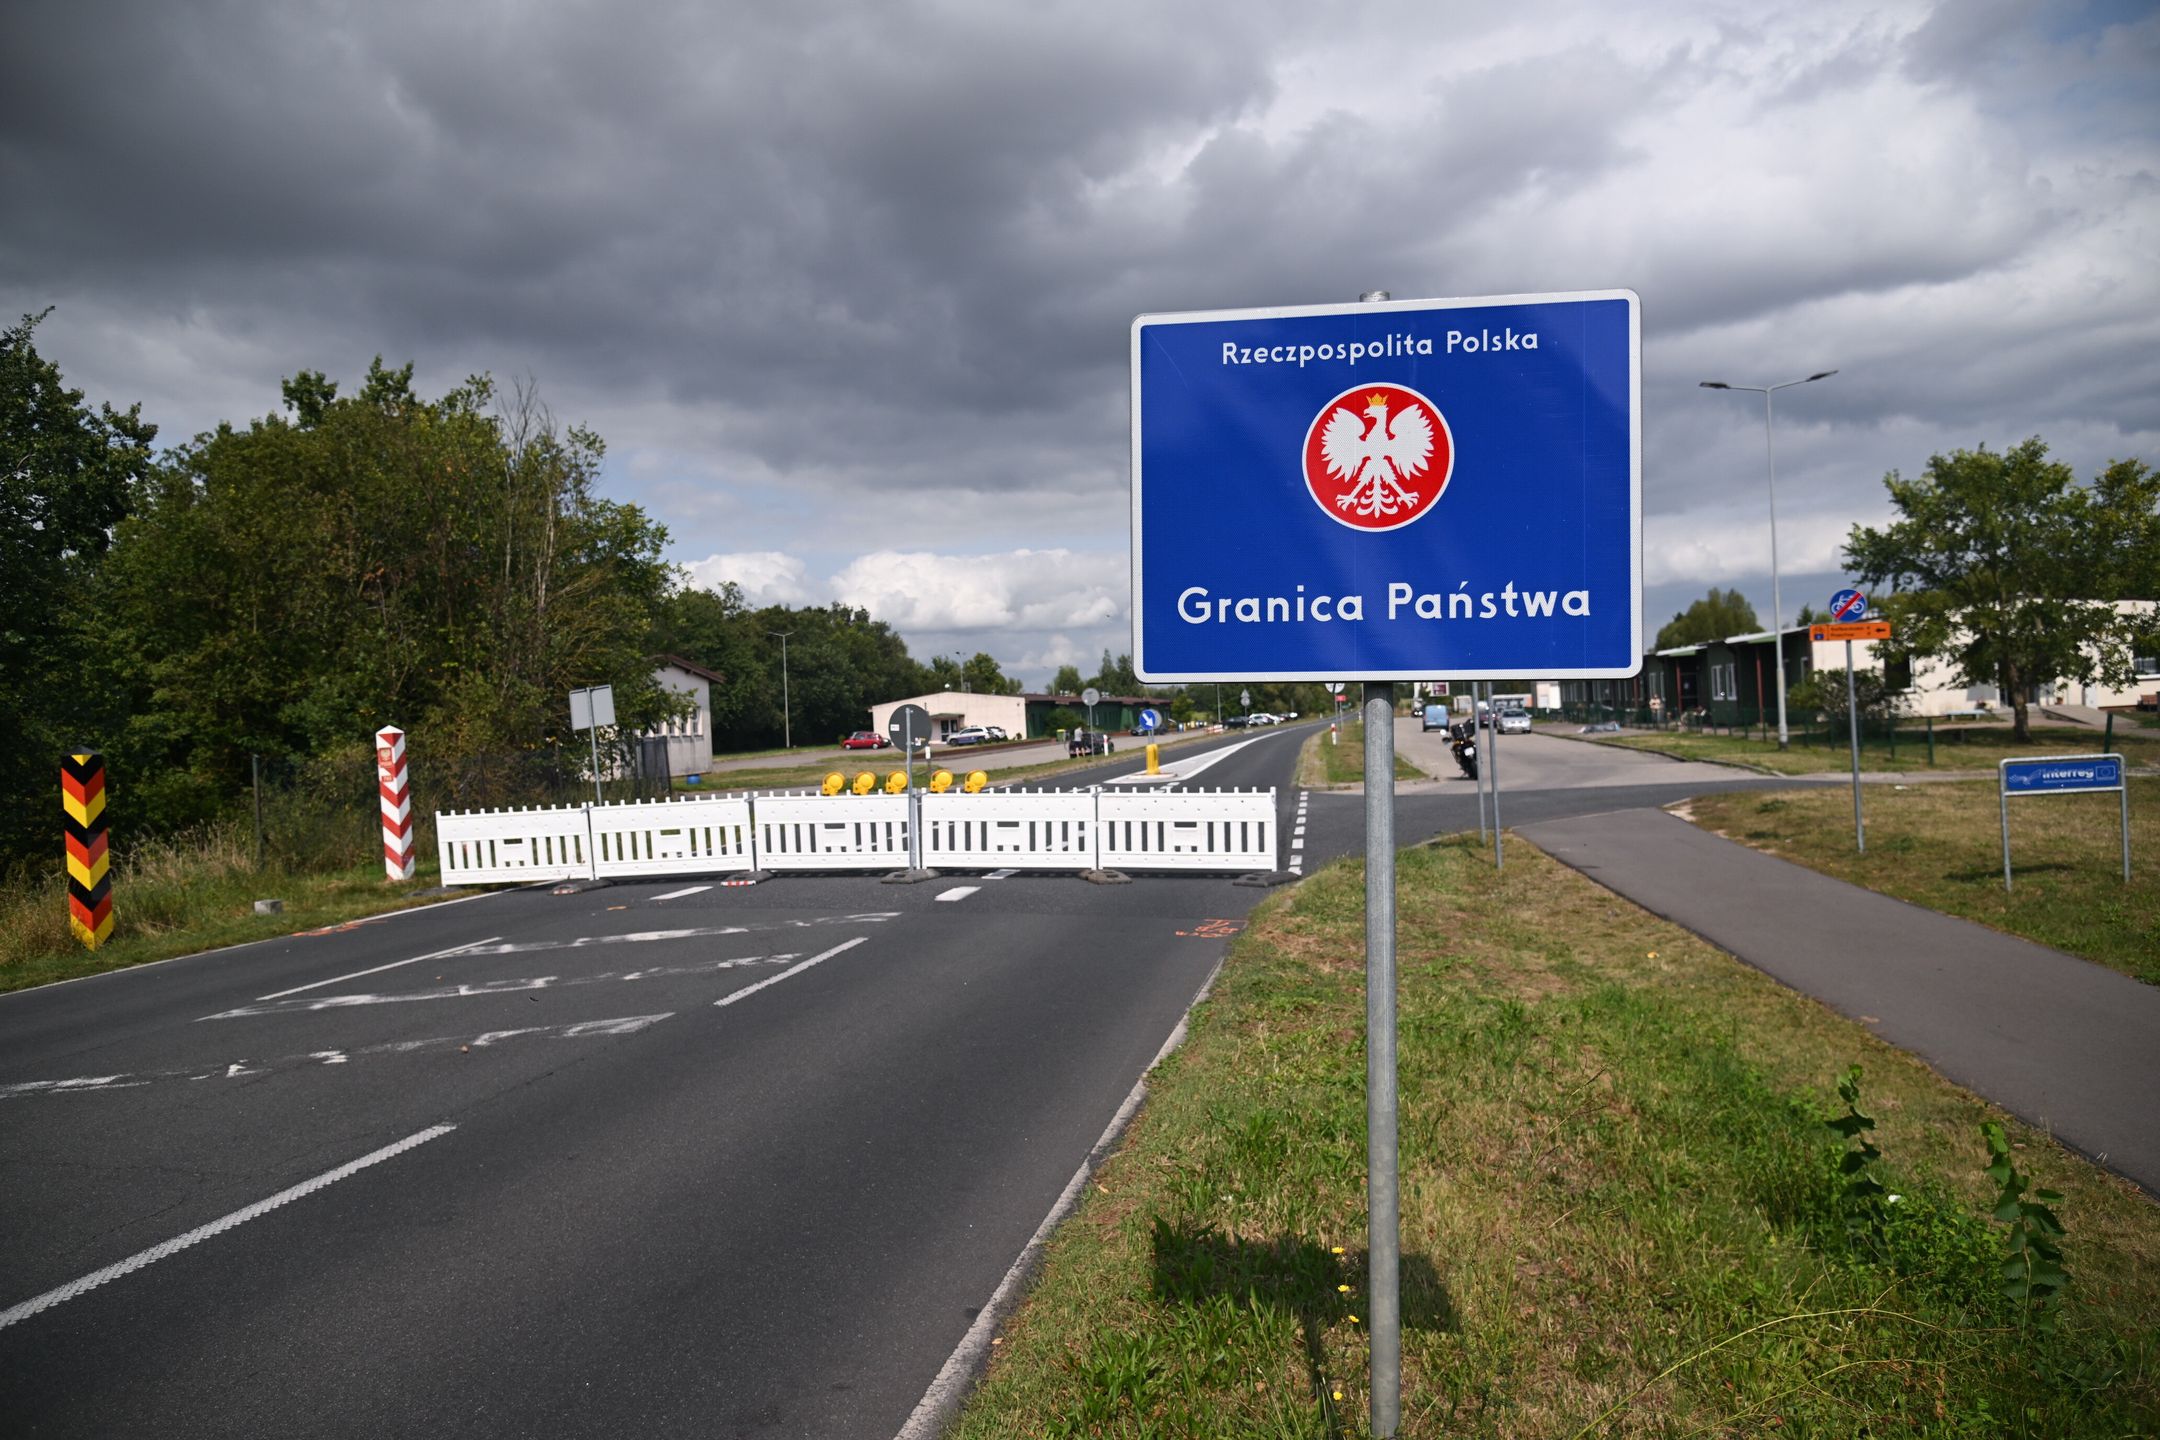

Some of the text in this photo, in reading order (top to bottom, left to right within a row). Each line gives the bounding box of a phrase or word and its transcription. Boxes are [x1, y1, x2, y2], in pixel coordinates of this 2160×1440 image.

[1222, 327, 1538, 368] Rzeczpospolita Polska
[1177, 580, 1591, 624] Granica Państwa
